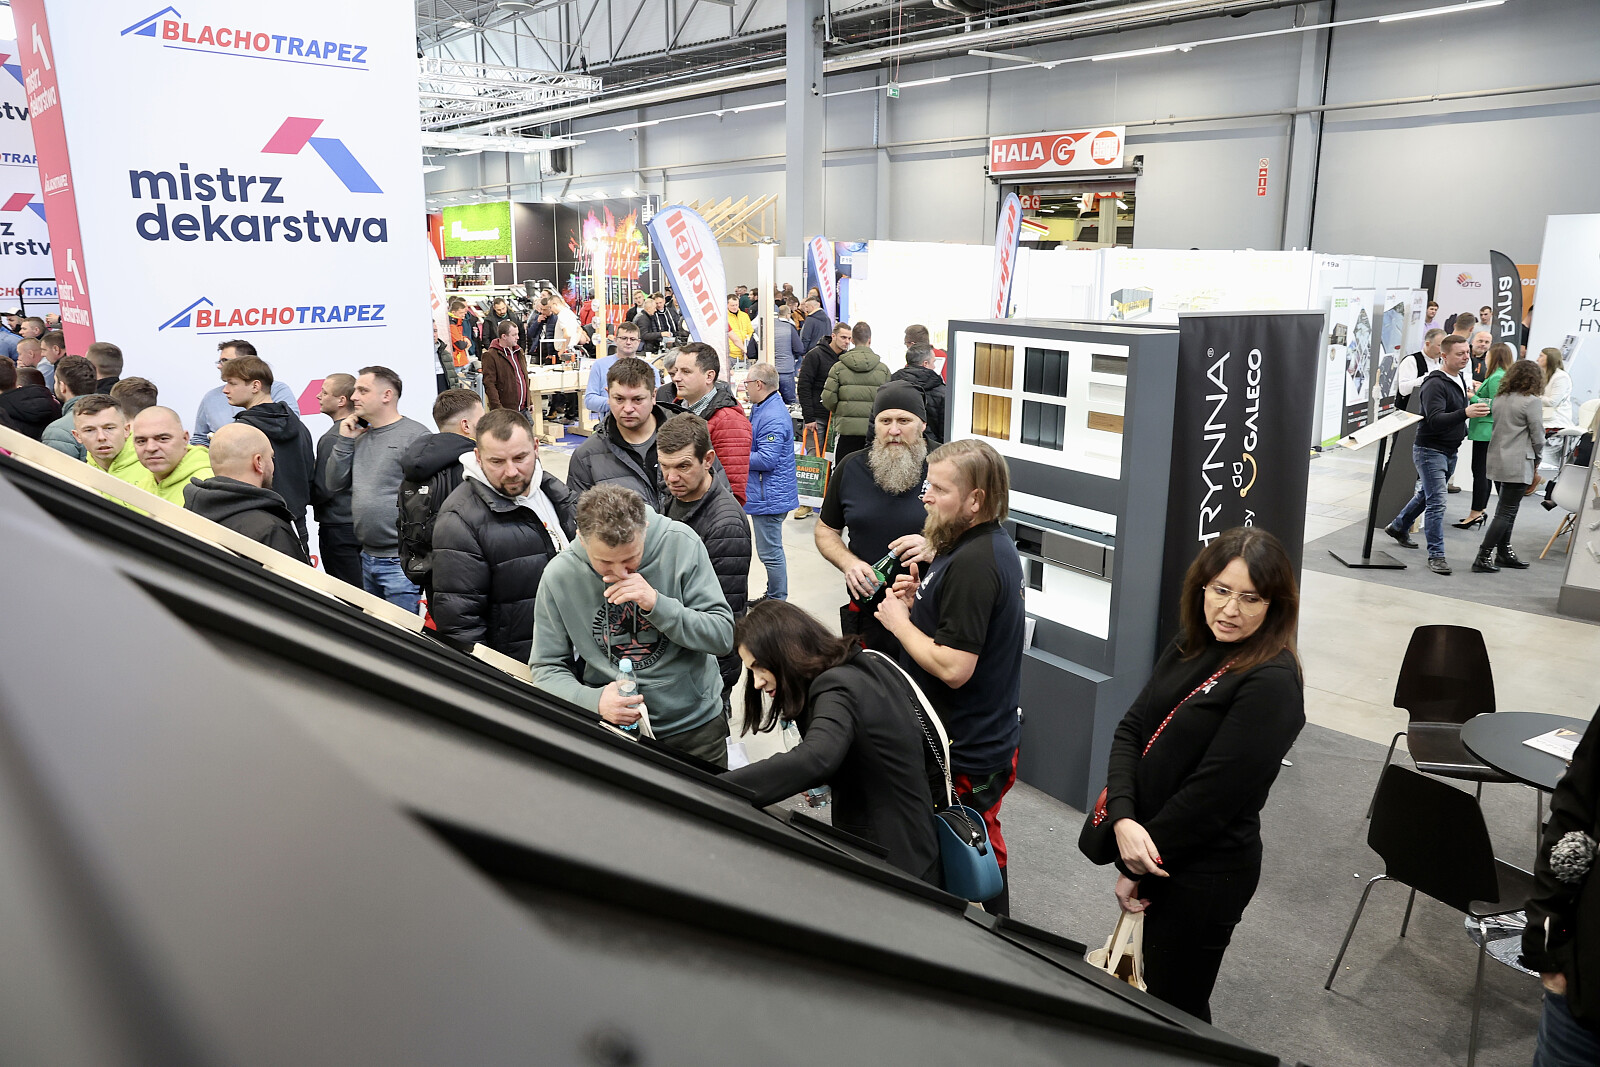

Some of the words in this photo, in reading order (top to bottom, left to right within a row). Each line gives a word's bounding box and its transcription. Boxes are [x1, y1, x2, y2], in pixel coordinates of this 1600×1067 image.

[162, 19, 368, 64] BLACHOTRAPEZ
[994, 142, 1045, 163] HALA
[129, 163, 285, 204] mistrz
[136, 204, 388, 243] dekarstwa
[195, 304, 386, 328] BLACHOTRAPEZ
[1243, 348, 1262, 452] GALECO
[795, 471, 820, 480] GREEN
